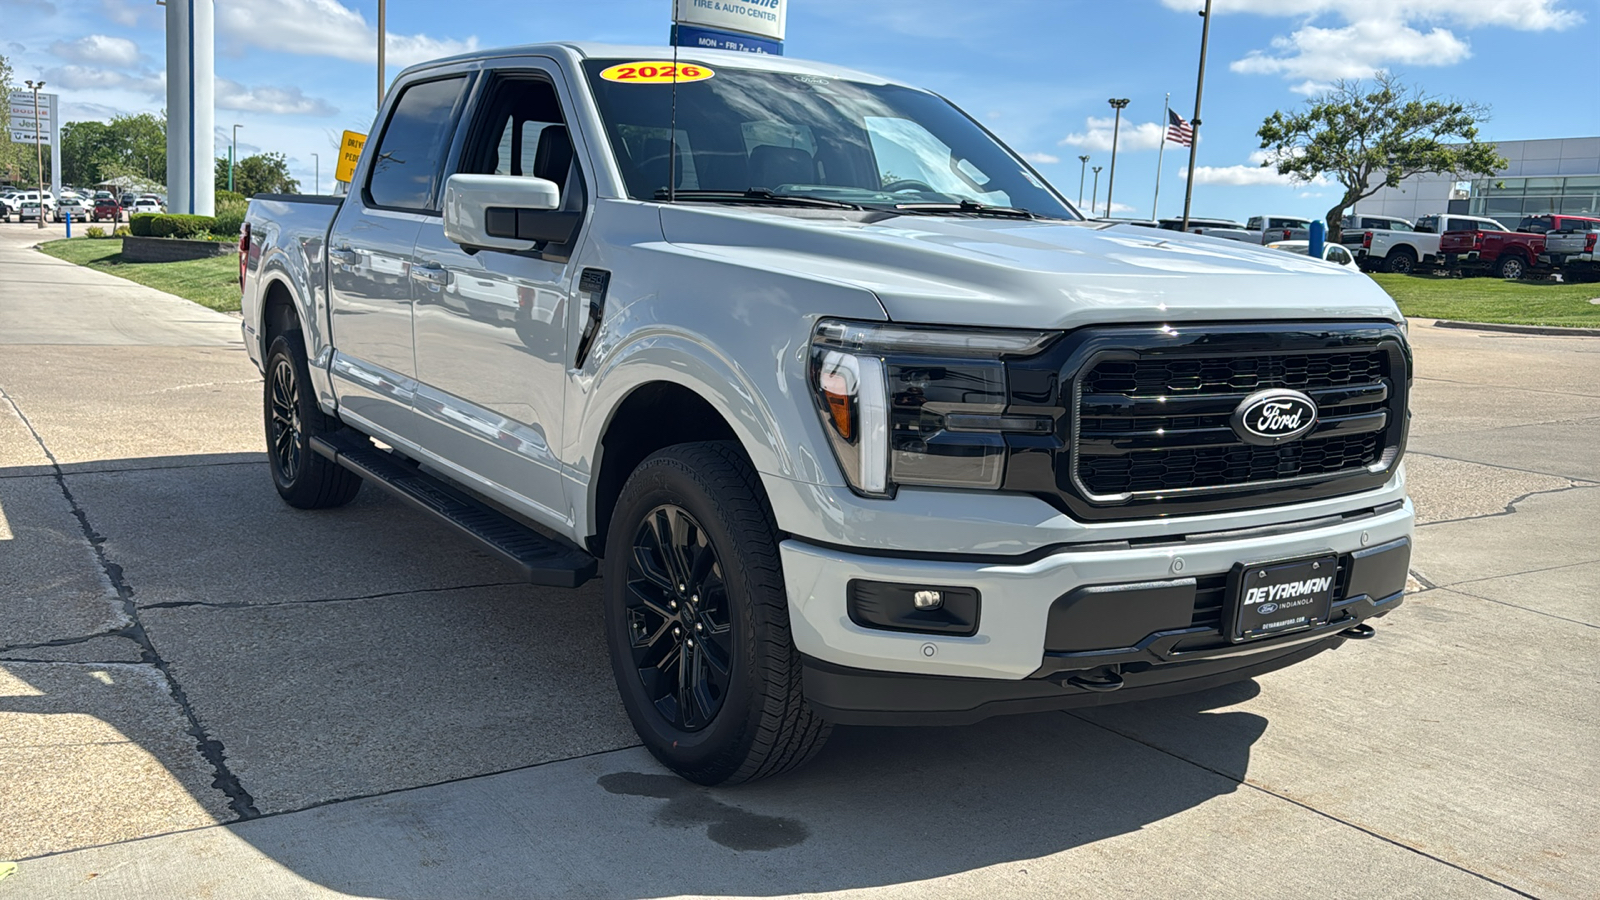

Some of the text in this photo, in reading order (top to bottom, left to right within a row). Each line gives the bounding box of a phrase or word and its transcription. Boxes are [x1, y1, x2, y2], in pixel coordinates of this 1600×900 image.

[693, 0, 777, 22] TIRE & AUTO CENTER
[740, 0, 779, 9] ane
[698, 37, 717, 47] MON
[725, 41, 738, 50] FRI
[617, 66, 700, 79] 2026
[1257, 402, 1303, 431] Ford
[1243, 576, 1333, 606] DEYARMAN
[1278, 598, 1314, 610] INDIANOLA
